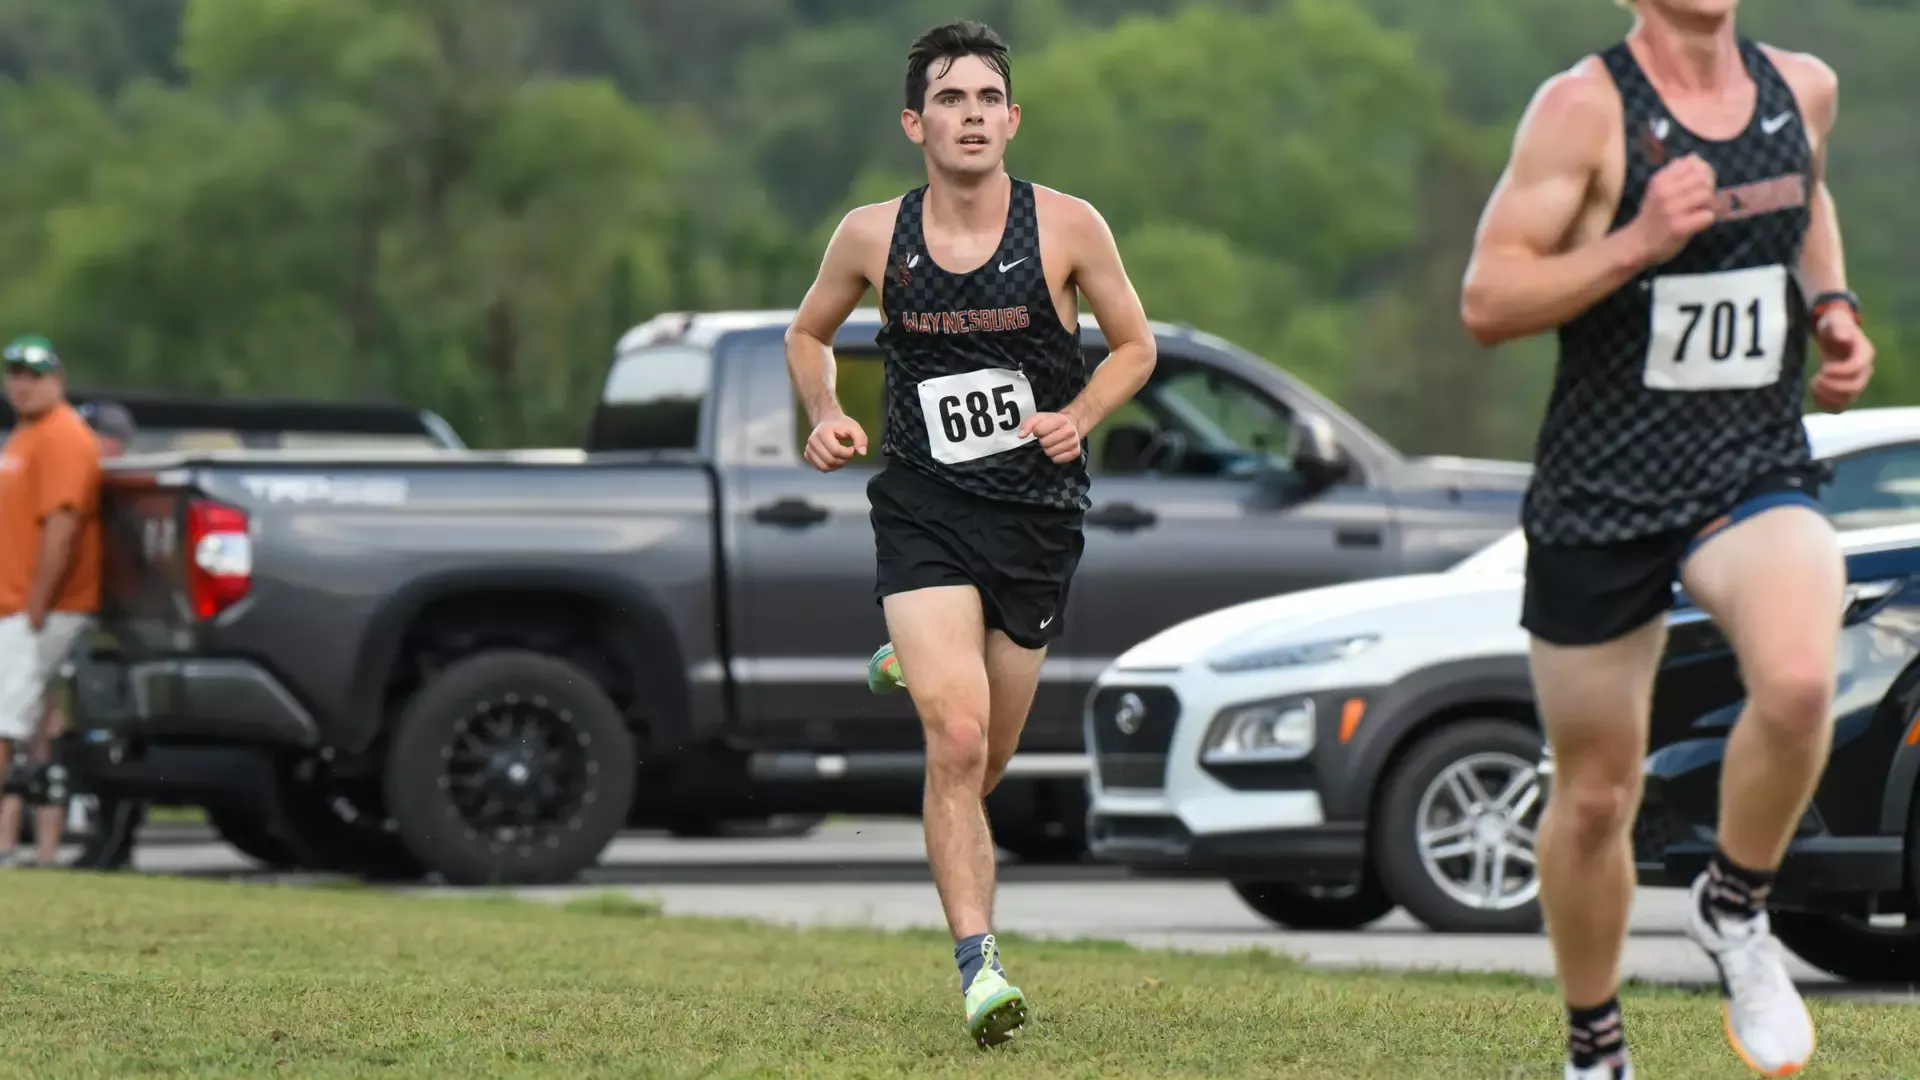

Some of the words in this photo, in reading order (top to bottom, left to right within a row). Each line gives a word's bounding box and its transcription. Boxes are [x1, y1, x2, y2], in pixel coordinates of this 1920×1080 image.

[903, 305, 1029, 334] WAYNESBURG
[1673, 298, 1766, 364] 701
[938, 384, 1021, 443] 685
